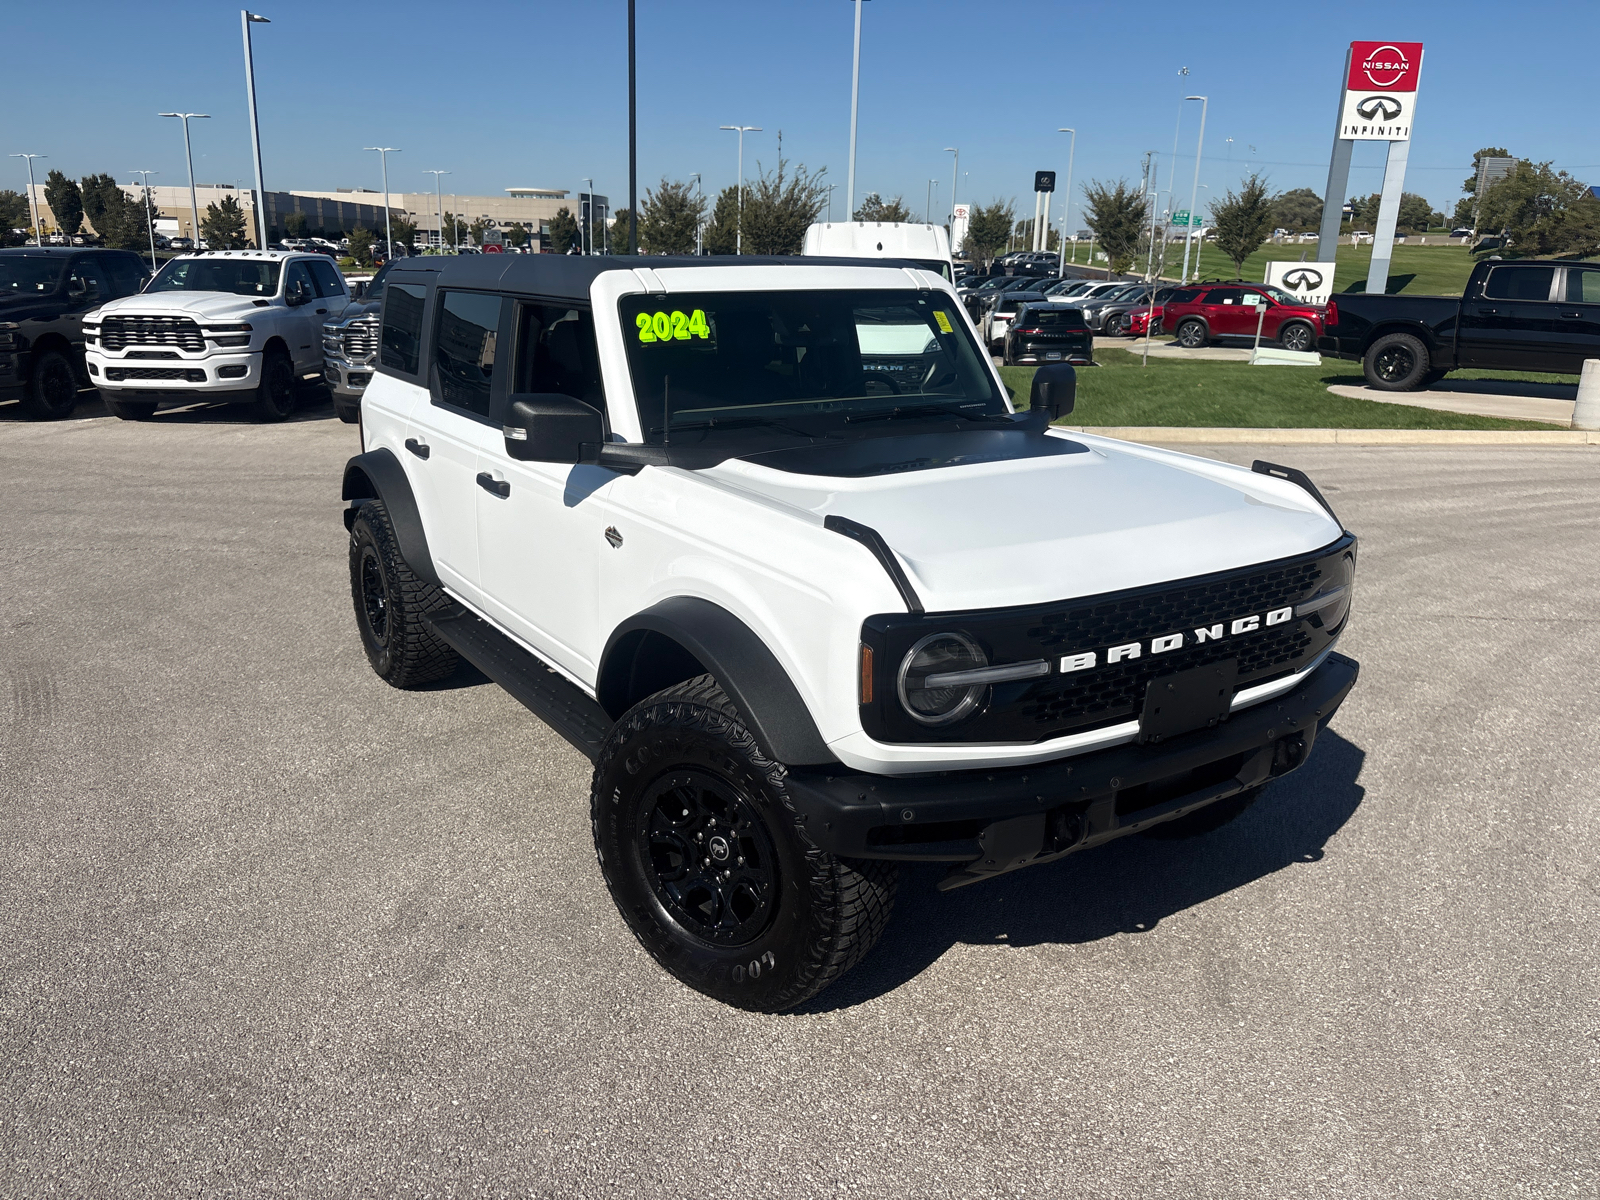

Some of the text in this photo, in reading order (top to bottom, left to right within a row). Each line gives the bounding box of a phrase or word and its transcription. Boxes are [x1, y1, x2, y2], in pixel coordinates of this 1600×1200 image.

[1362, 61, 1409, 70] NISSAN
[1344, 125, 1408, 136] INFINITI
[635, 309, 711, 343] 2024
[1060, 606, 1292, 674] BRONCO
